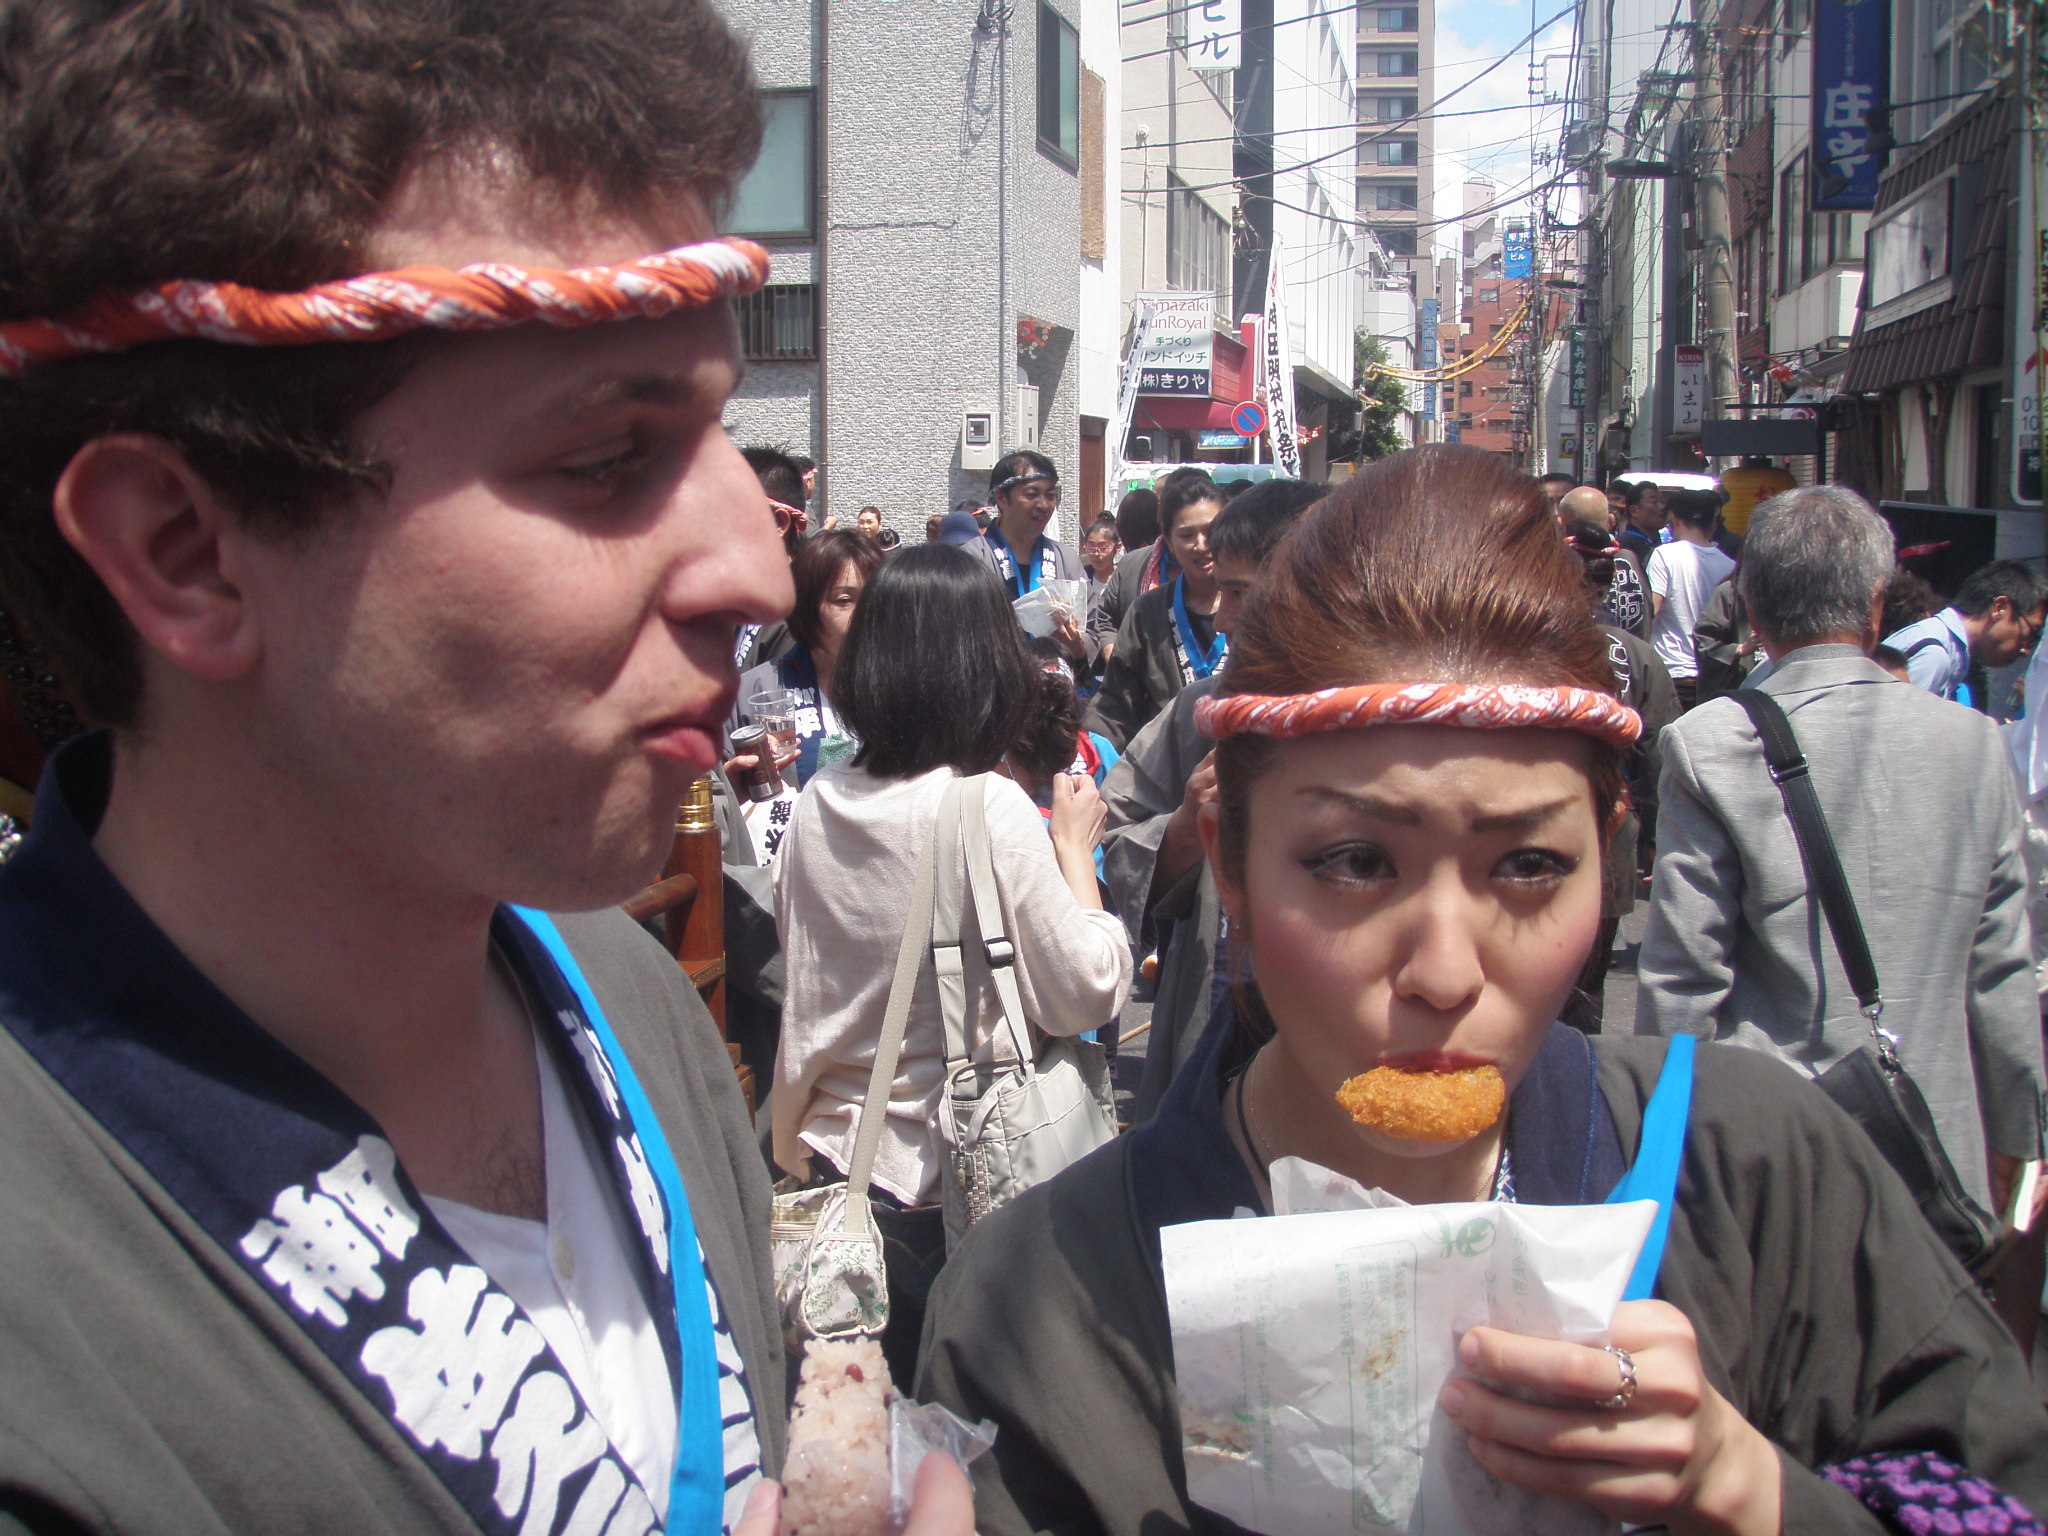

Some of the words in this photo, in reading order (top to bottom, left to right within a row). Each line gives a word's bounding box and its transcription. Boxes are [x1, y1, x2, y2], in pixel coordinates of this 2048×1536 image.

[1824, 81, 1873, 178] 庄や
[1140, 298, 1209, 312] Ymazaki
[1151, 316, 1207, 333] unRoyal
[1155, 336, 1192, 347] 手づくり
[1140, 373, 1206, 390] (株)きりや
